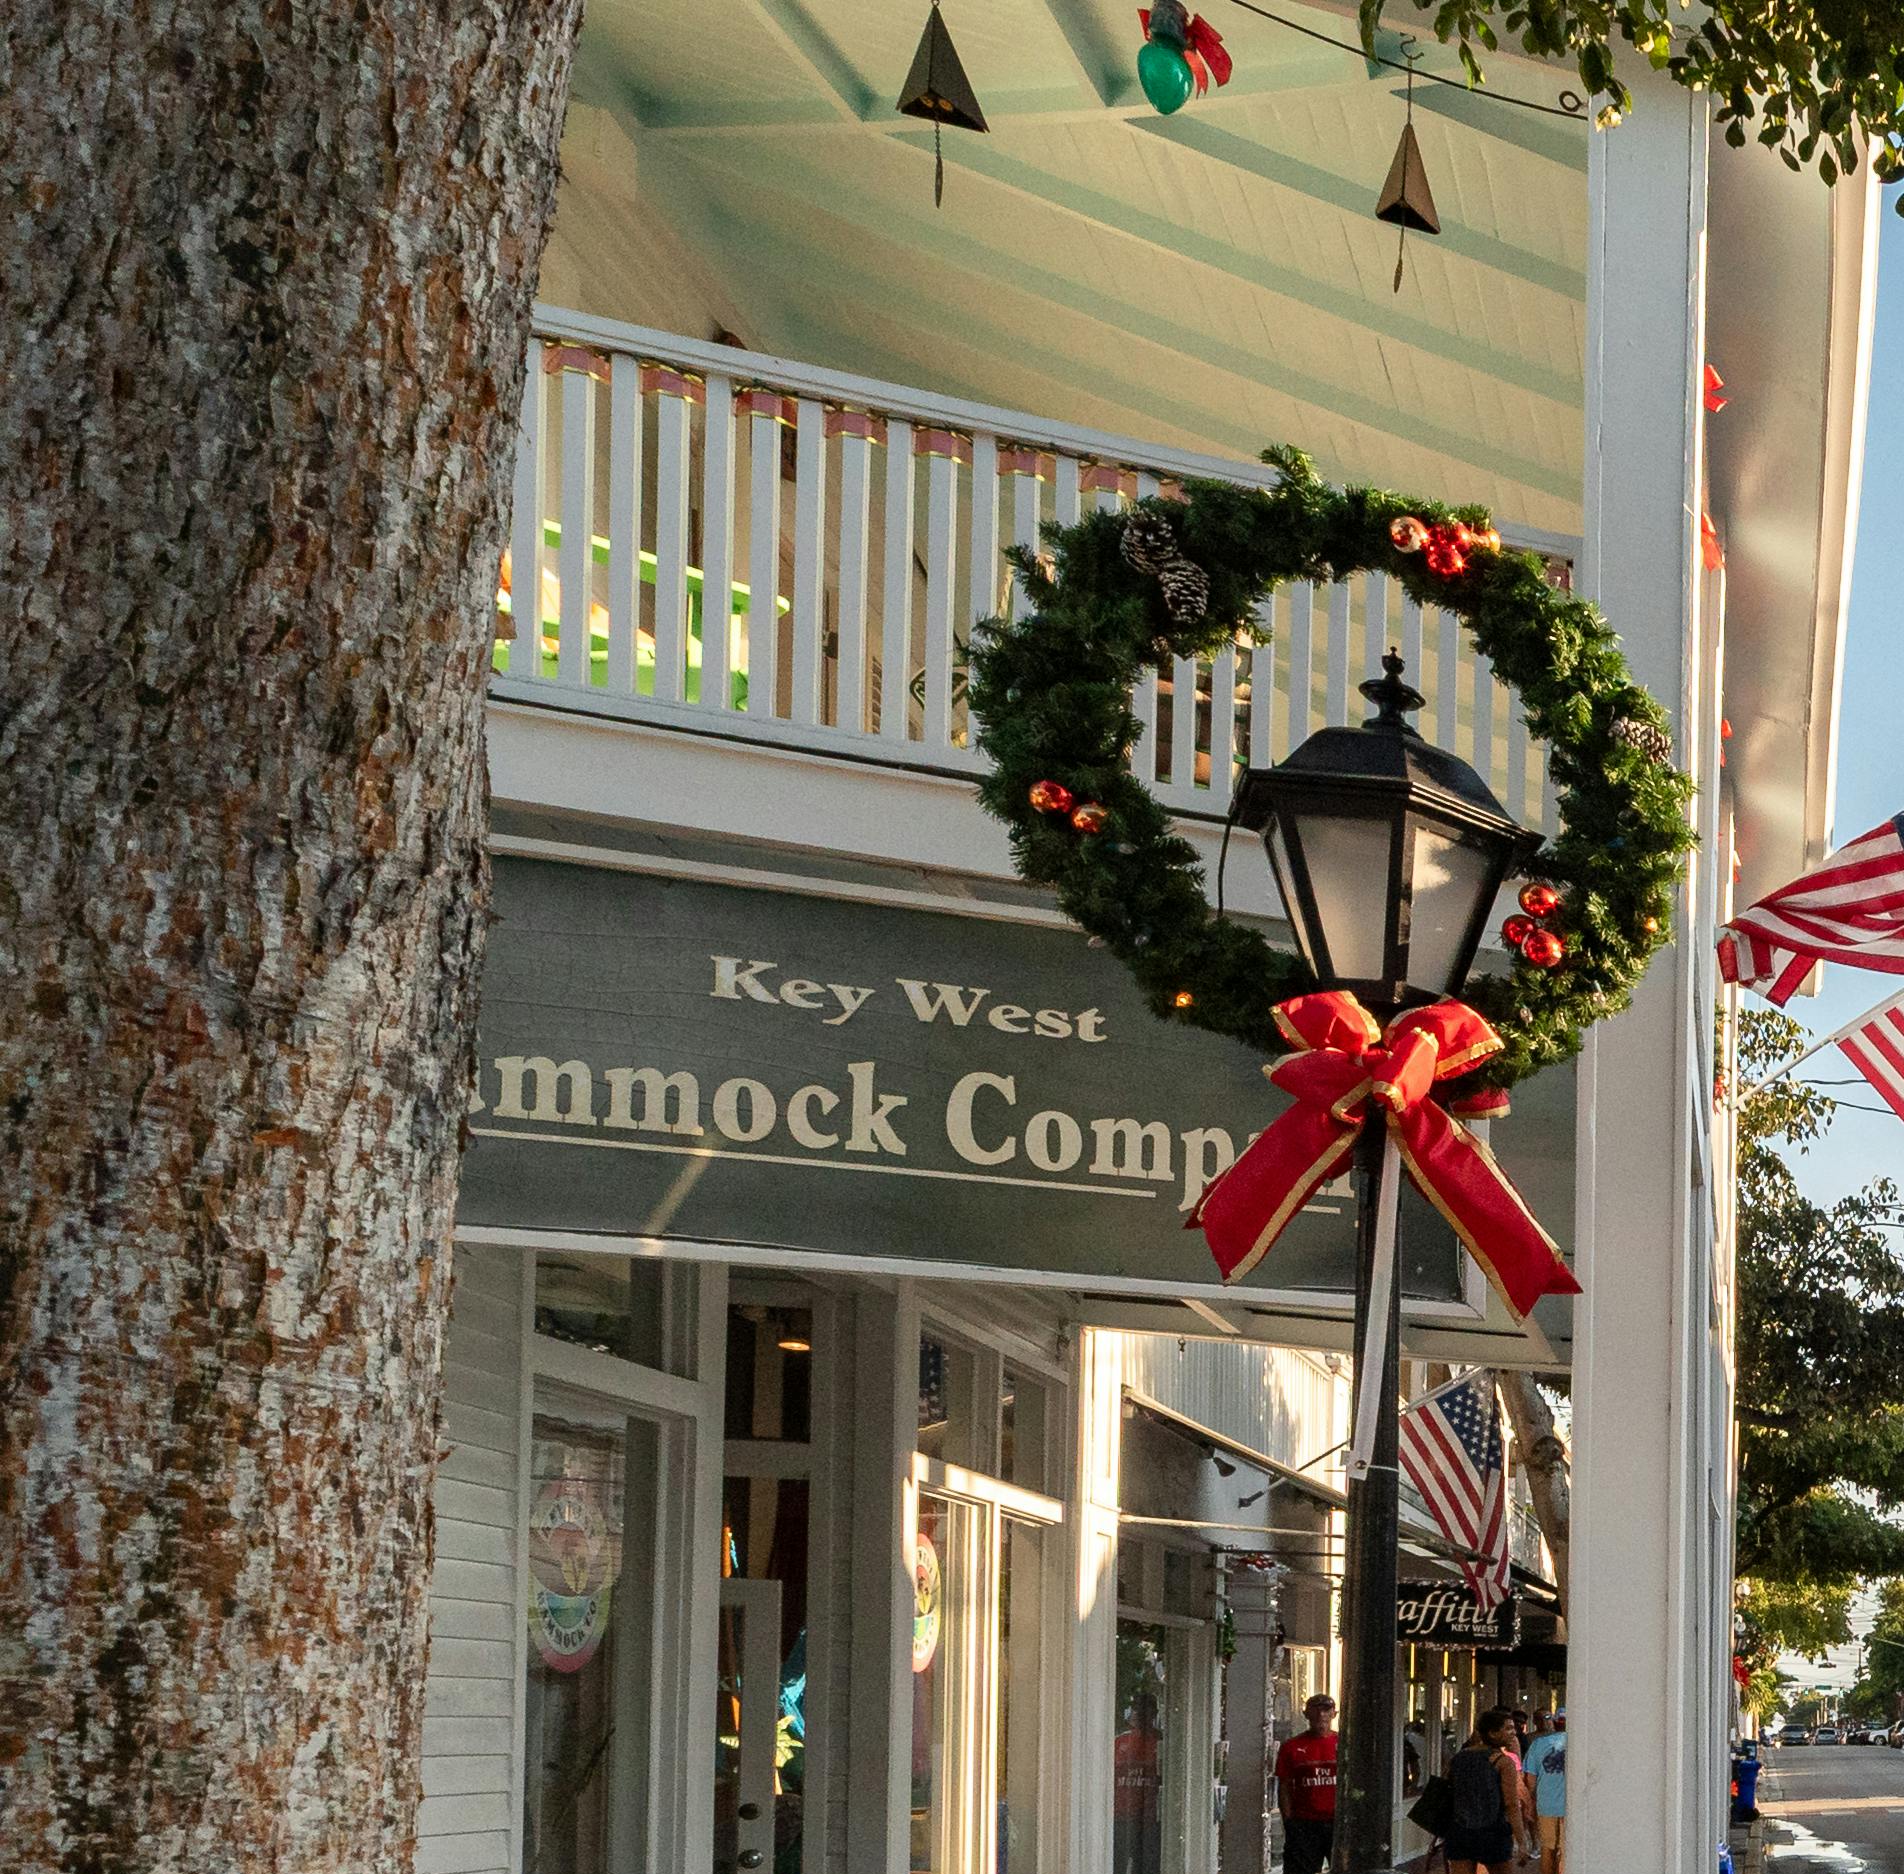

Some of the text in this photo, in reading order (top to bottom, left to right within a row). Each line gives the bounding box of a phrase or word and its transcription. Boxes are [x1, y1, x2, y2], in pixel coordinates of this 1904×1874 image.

[710, 954, 1108, 1043] Key West
[468, 1054, 1356, 1213] mmock Comp
[1451, 1624, 1500, 1634] KEY WEST
